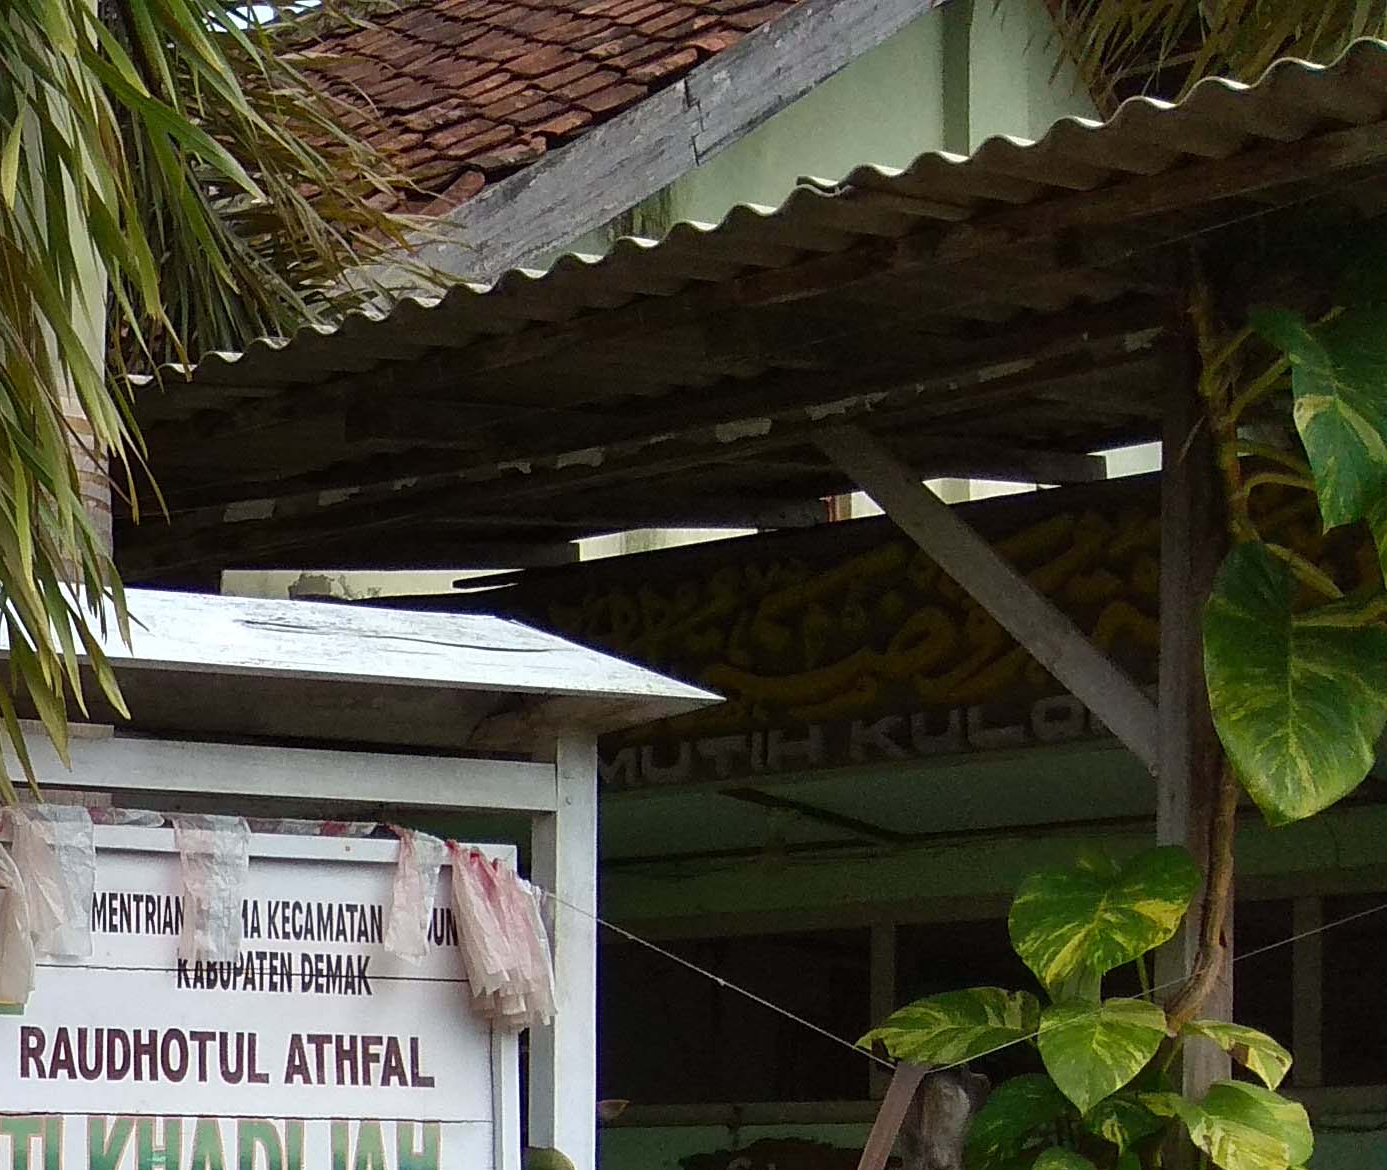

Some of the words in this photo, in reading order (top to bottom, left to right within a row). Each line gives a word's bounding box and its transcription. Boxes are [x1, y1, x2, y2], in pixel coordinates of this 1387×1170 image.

[598, 720, 823, 784] MUTIH
[90, 891, 185, 936] MENTRIAN
[267, 900, 383, 944] KECAMATAN
[176, 948, 292, 994] KABUPATEN
[300, 953, 372, 996] DEMAK
[19, 1025, 270, 1085] RAUDHOTUL
[284, 1033, 436, 1089] ATHFAL
